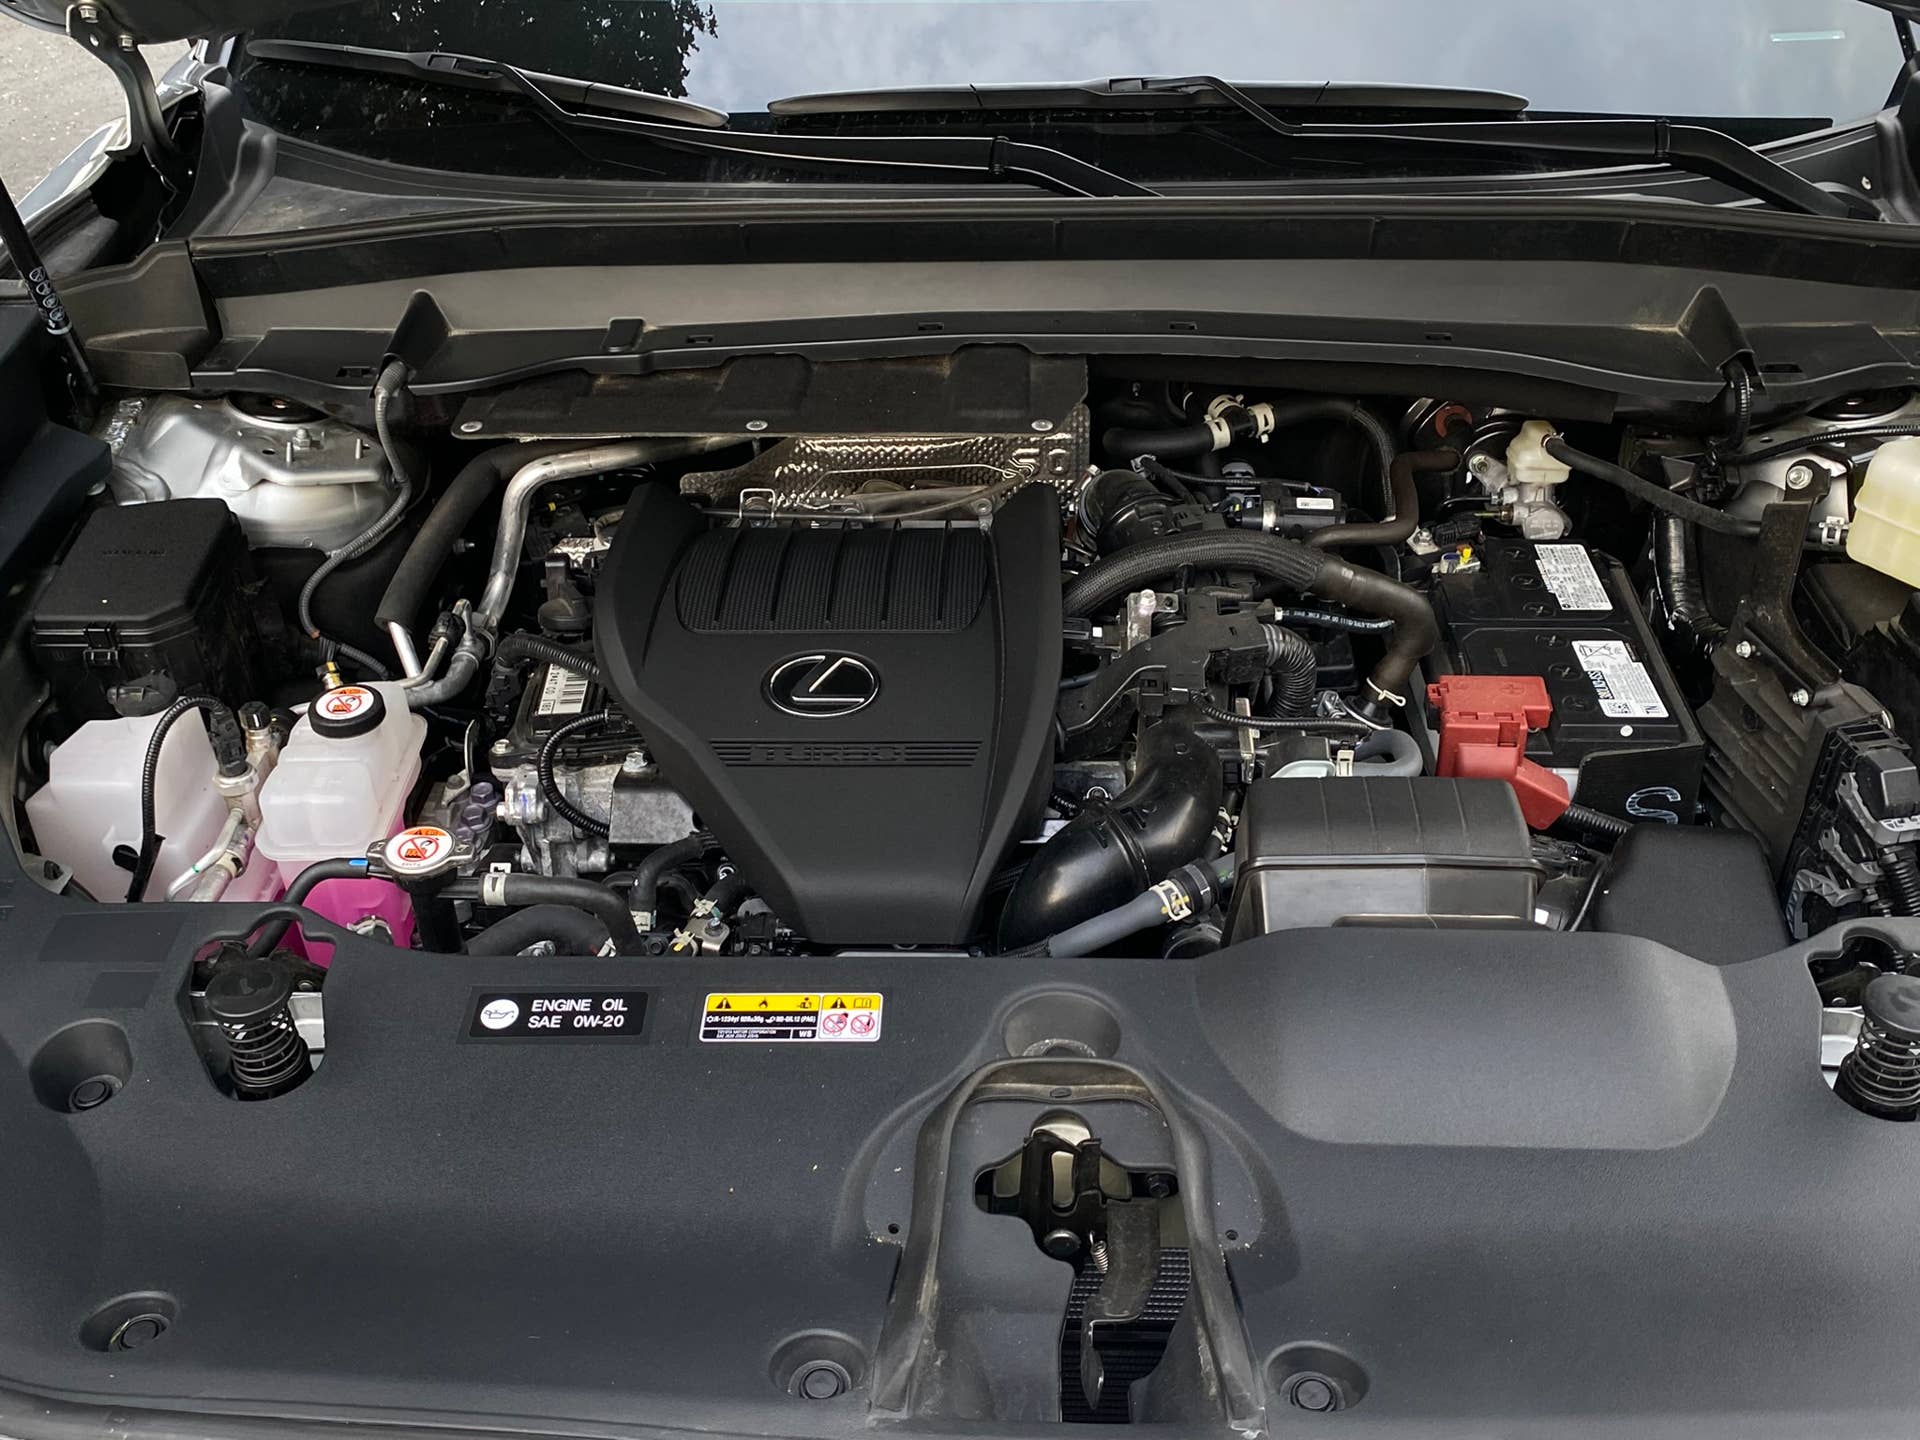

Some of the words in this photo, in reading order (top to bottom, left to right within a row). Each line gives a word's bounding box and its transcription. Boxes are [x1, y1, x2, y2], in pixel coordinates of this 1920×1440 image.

[753, 745, 901, 761] TURBO
[531, 999, 593, 1012] ENGINE
[602, 998, 628, 1011] OIL
[528, 1015, 562, 1028] SAE
[573, 1015, 625, 1028] 0W-20
